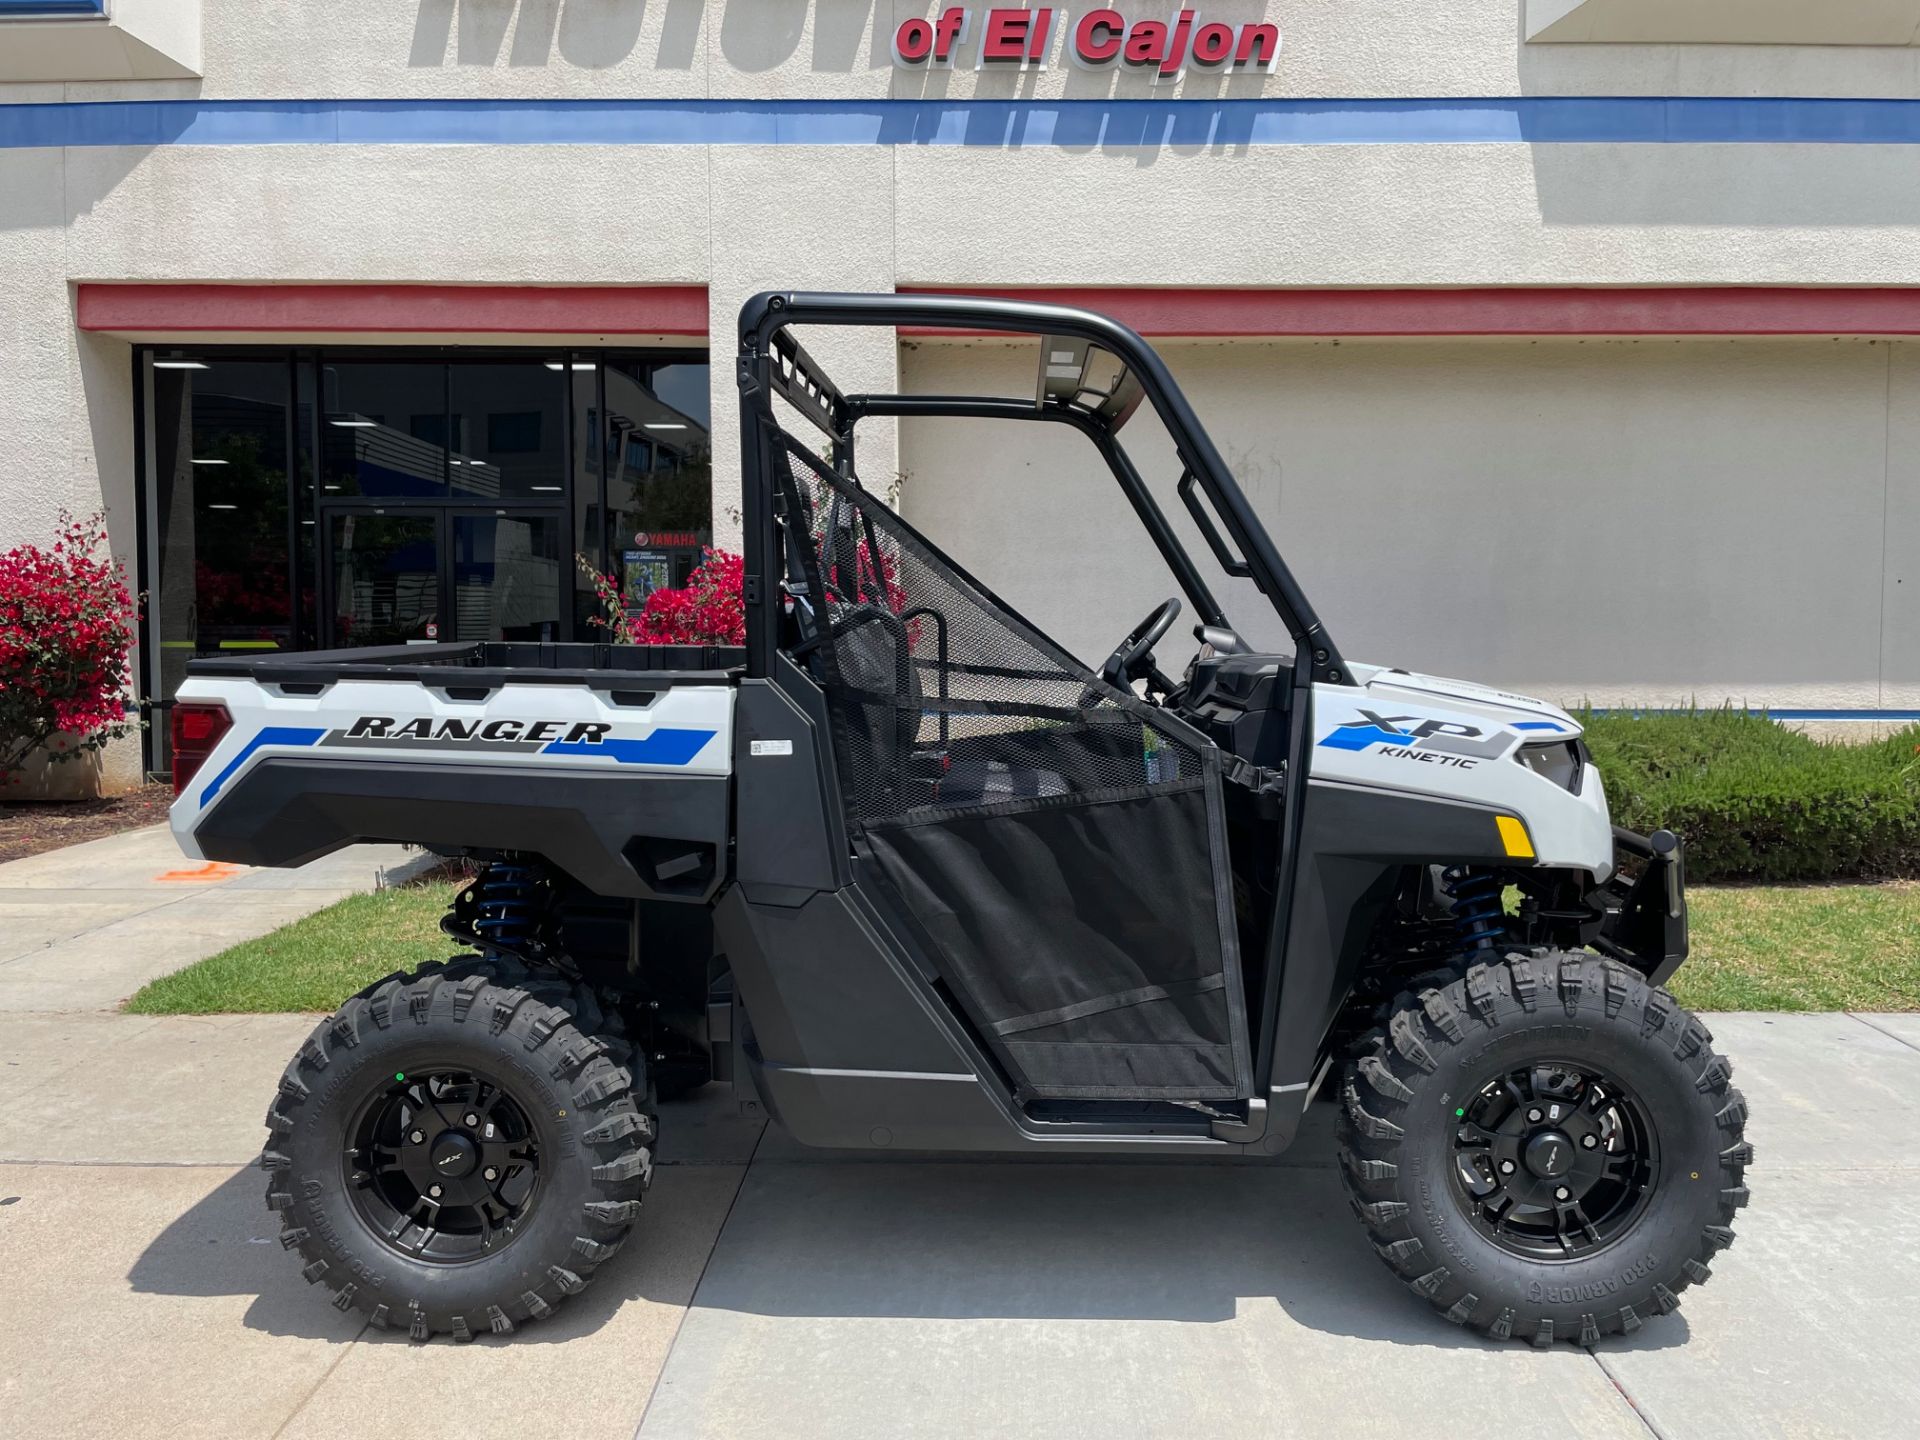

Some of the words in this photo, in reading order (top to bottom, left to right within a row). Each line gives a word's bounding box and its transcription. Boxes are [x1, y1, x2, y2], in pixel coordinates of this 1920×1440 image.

[895, 7, 964, 62] of
[982, 8, 1053, 63] El
[1075, 9, 1280, 78] Cajon
[648, 533, 697, 546] YAMAHA
[346, 716, 613, 743] RANGER
[1336, 708, 1484, 738] XP
[1378, 746, 1478, 769] KINETIC
[1621, 1253, 1660, 1285] PRO
[1545, 1278, 1619, 1304] ARMOR
